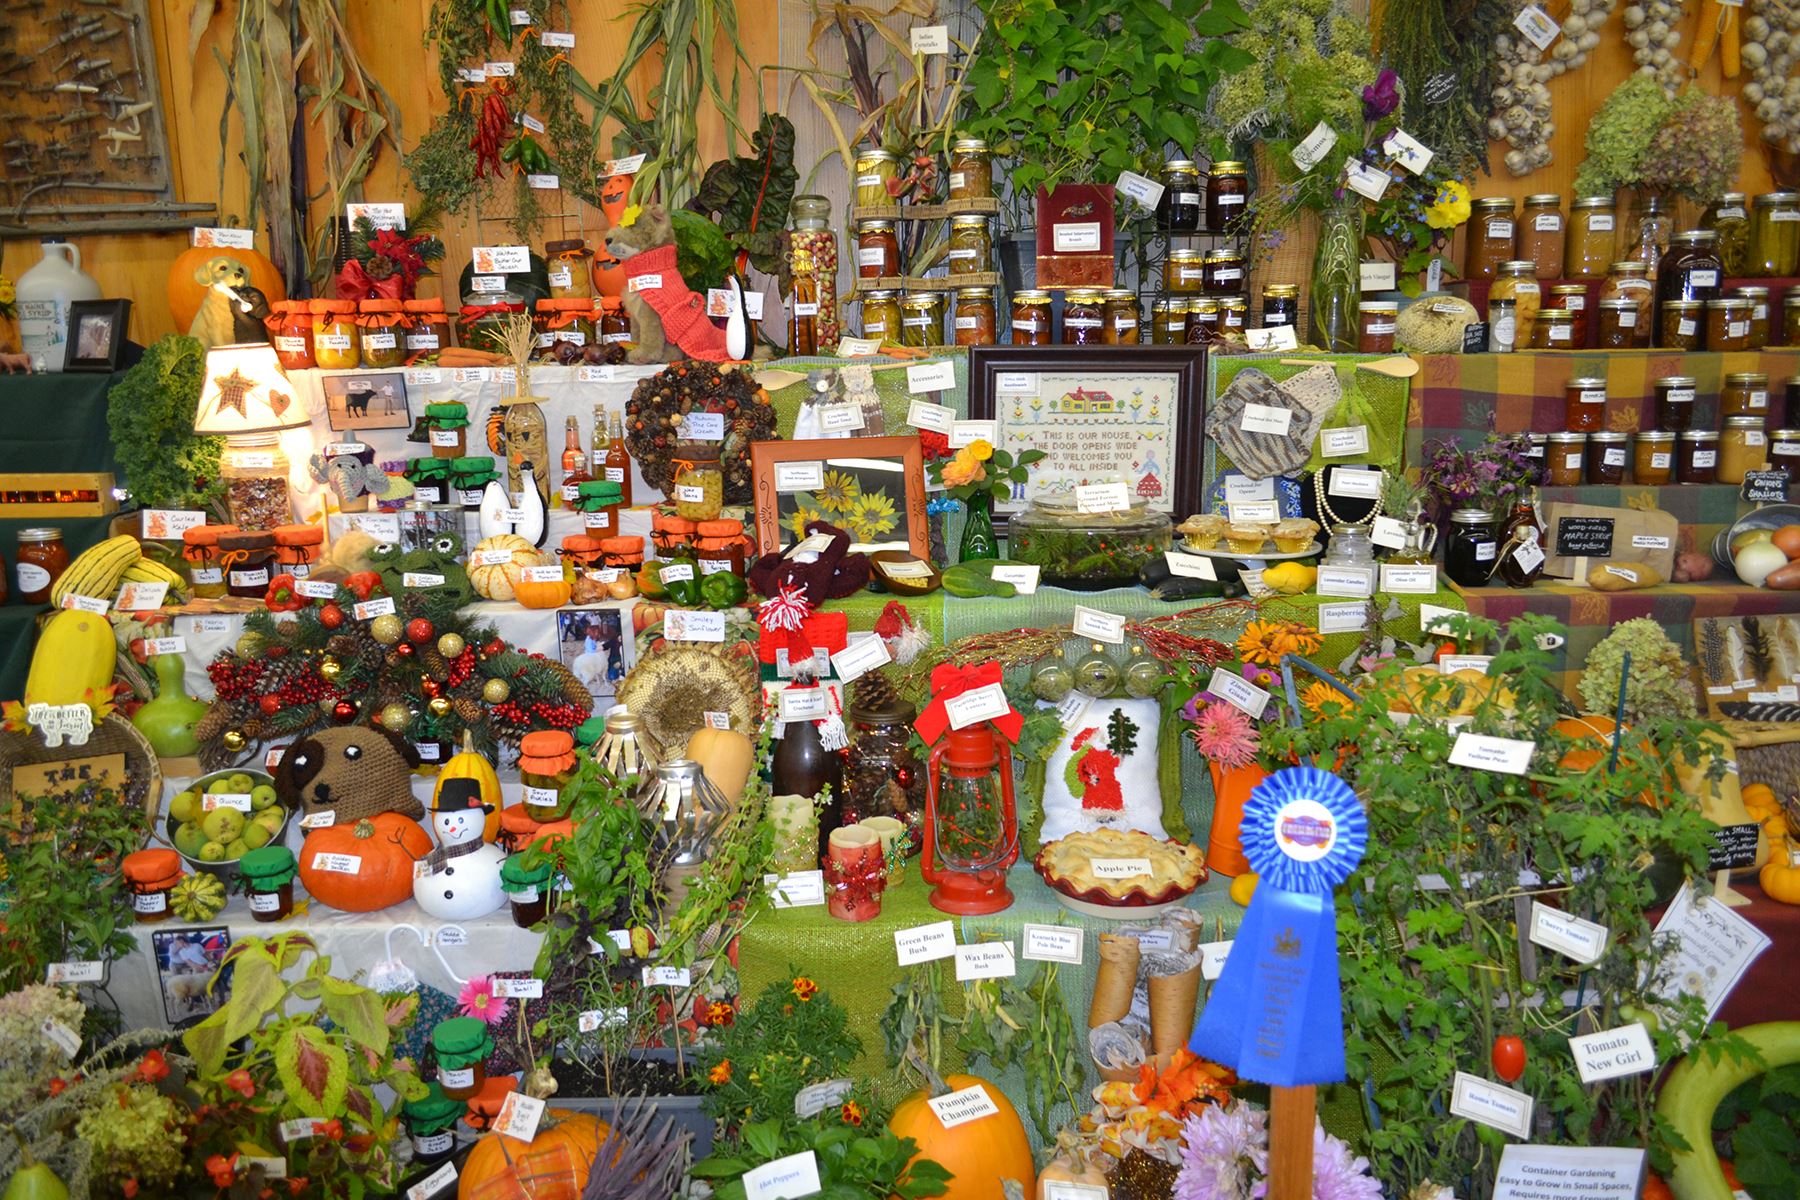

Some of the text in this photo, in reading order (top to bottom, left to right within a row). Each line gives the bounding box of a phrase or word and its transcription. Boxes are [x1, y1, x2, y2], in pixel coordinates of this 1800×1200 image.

[911, 374, 944, 383] Accessories
[1042, 430, 1063, 440] THIS
[1066, 432, 1074, 440] IS
[1078, 432, 1098, 440] OUR
[1034, 441, 1138, 450] THE DOOR OPENS WIDE
[1062, 452, 1111, 461] WELCOMES
[1114, 452, 1133, 460] YOU
[1053, 462, 1119, 472] TO ALL INSIDE
[1563, 532, 1589, 540] MAPLE
[1326, 609, 1365, 619] Raspberries
[1096, 865, 1126, 874] Apple
[1539, 917, 1591, 944] Cherry Tomato
[898, 931, 946, 947] Green Beans
[908, 946, 928, 956] Bush
[982, 952, 1005, 961] Beans
[1582, 1036, 1630, 1055] Tomato
[1586, 1050, 1643, 1073] New Girl
[937, 1092, 982, 1111] Pumpkin
[1490, 1099, 1518, 1115] Tomato
[940, 1102, 991, 1124] Champion
[1521, 1164, 1617, 1180] Container Gardening
[759, 1170, 801, 1190] Hot Peppers
[1499, 1176, 1633, 1193] Easy to Grow in Small Spaces,
[1508, 1188, 1551, 1200] Requires
